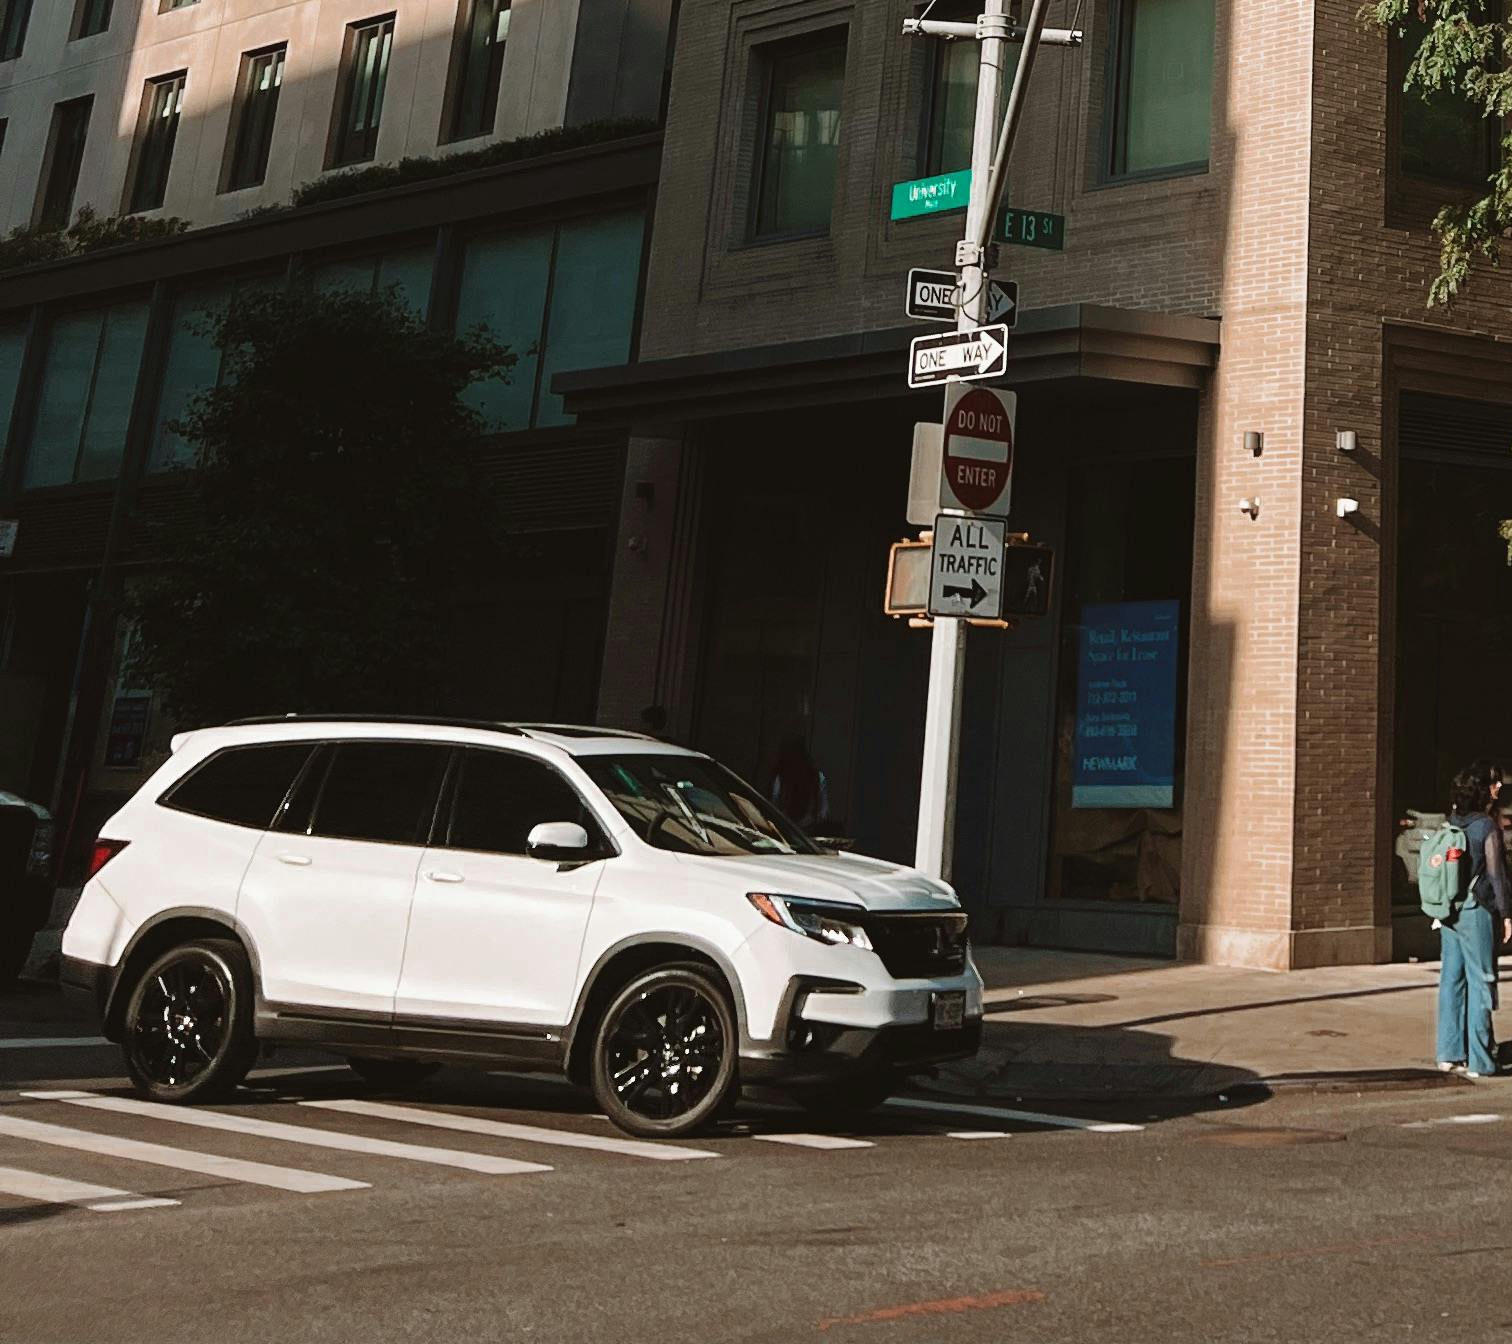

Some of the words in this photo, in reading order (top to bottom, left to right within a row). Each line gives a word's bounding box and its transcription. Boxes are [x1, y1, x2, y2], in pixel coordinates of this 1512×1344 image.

[909, 178, 957, 201] University
[1005, 213, 1013, 237] E
[1021, 215, 1036, 241] 13
[919, 285, 951, 305] ONE
[919, 350, 947, 370] ONE
[963, 343, 993, 362] WAY
[958, 410, 975, 430] DO
[979, 414, 1003, 433] NOT
[957, 465, 997, 488] ENTER
[950, 524, 989, 550] ALL
[939, 553, 998, 576] TRAFFIC
